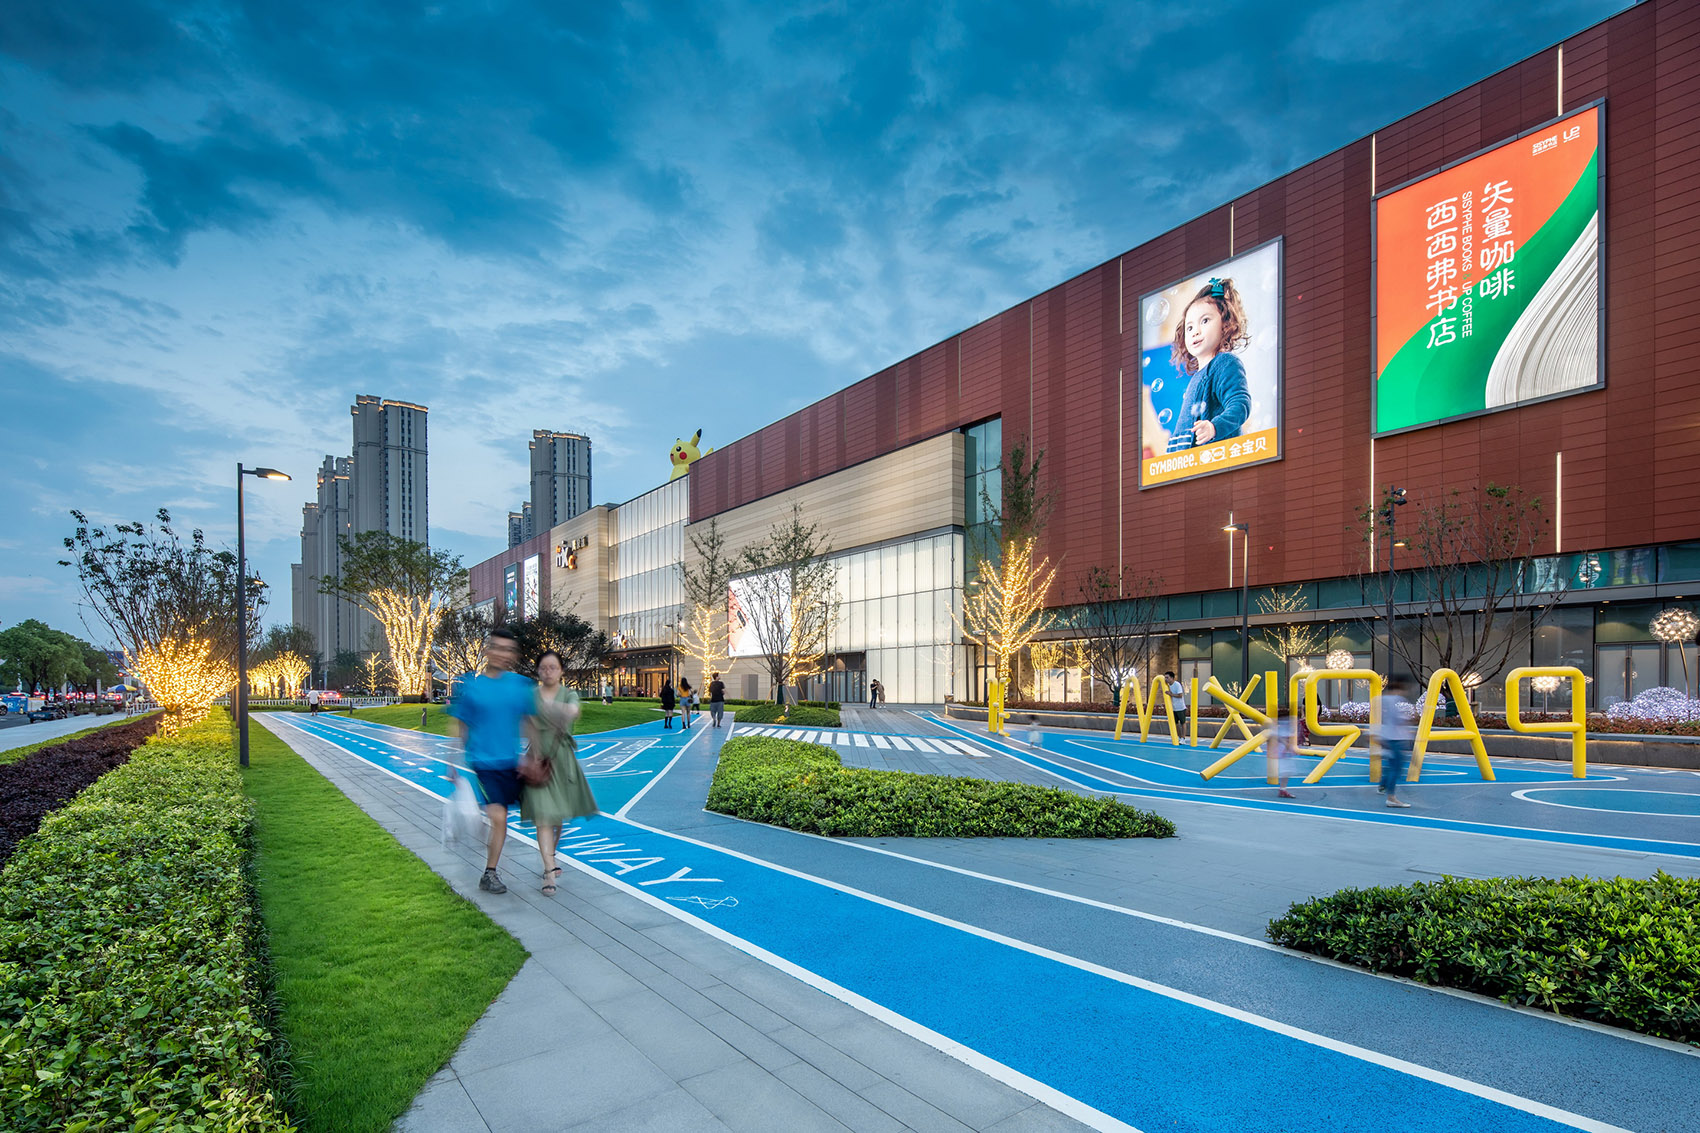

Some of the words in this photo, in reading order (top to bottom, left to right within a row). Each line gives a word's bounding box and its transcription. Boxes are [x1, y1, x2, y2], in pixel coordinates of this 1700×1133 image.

[1462, 191, 1472, 235] SISYPHE
[1462, 235, 1472, 272] BOOKS
[1480, 180, 1515, 300] 矢量咖啡
[1425, 197, 1458, 349] 西西弗书店
[1462, 281, 1472, 296] UP
[1462, 297, 1472, 338] COFFEE
[1229, 436, 1267, 459] 金宝贝
